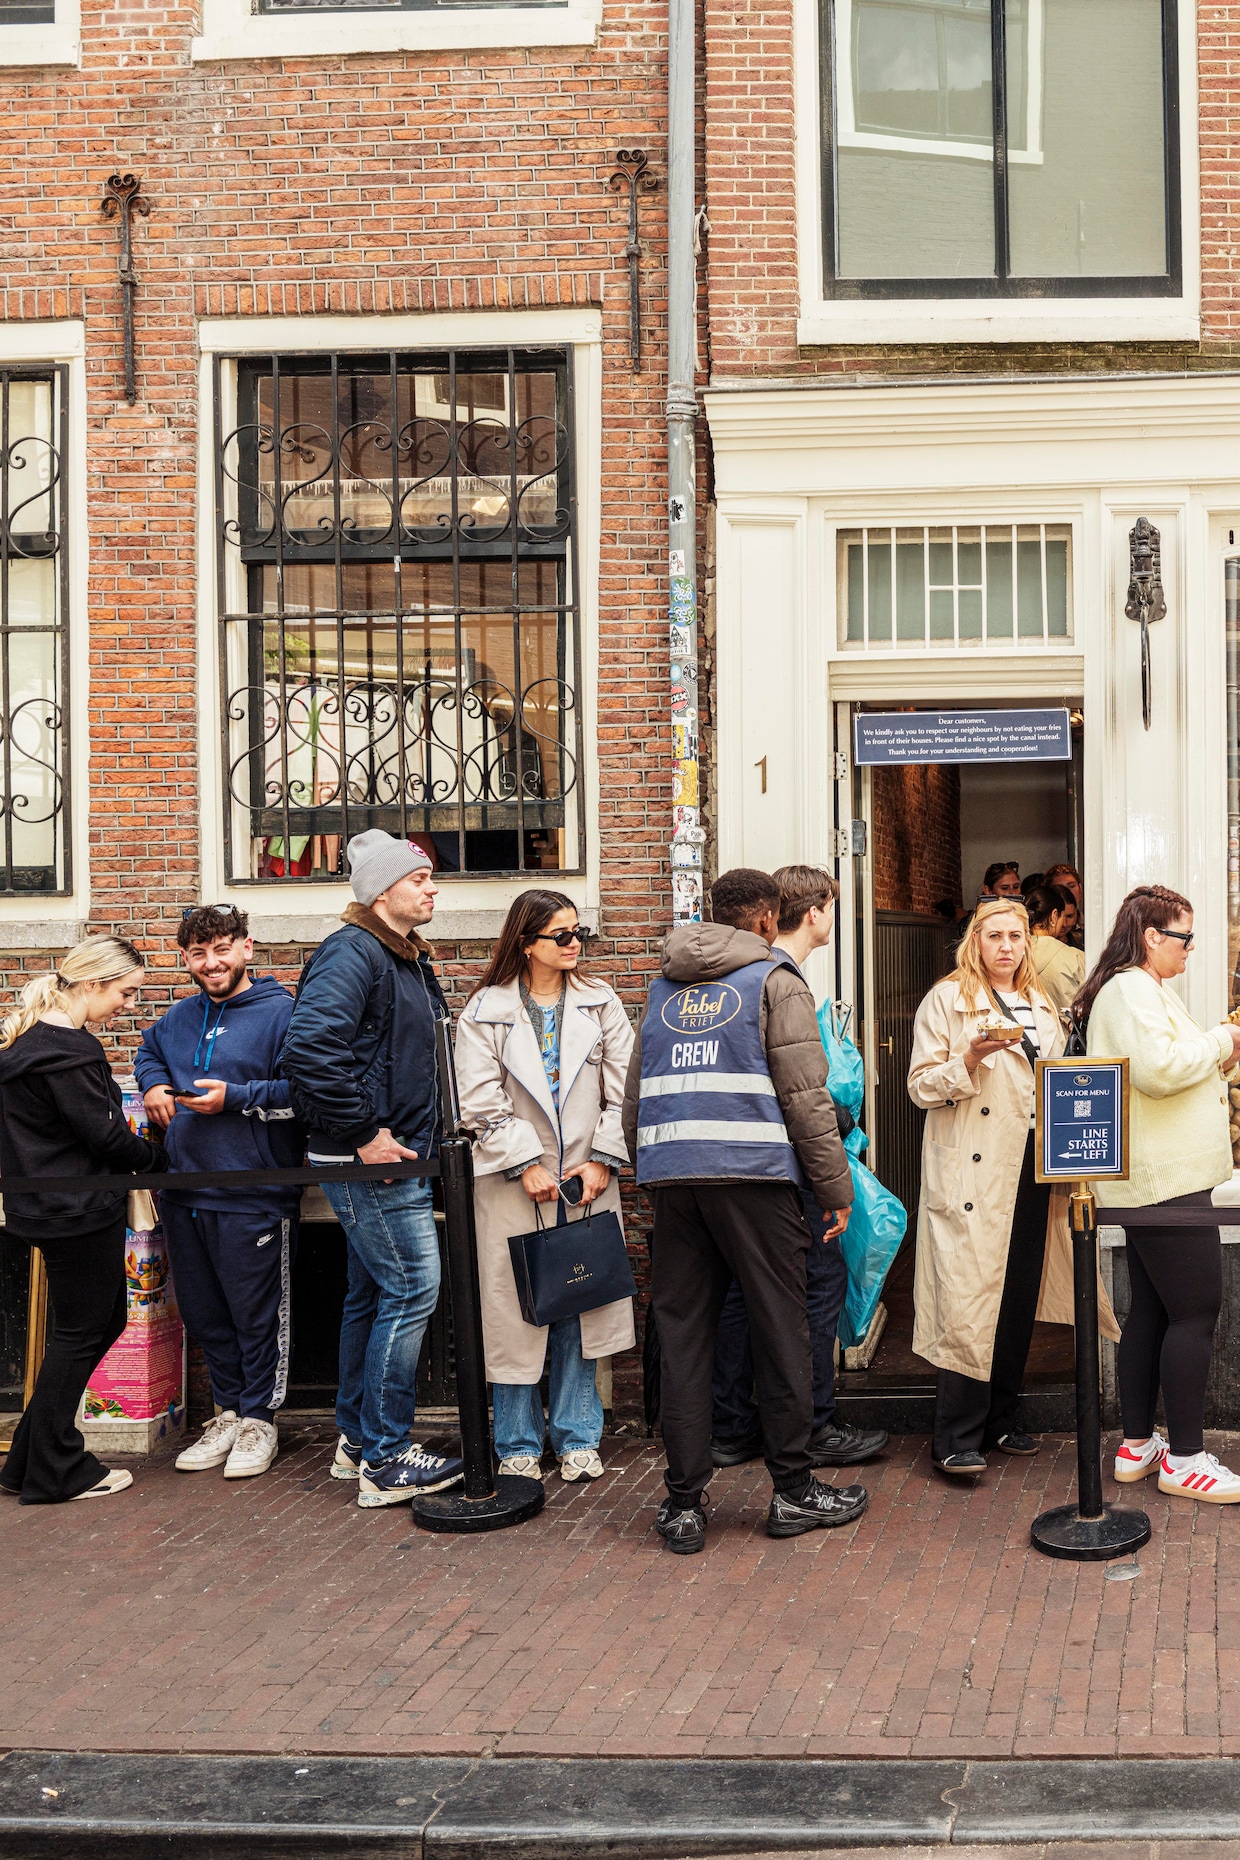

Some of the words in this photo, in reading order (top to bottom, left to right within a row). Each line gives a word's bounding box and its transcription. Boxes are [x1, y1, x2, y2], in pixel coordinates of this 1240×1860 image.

[874, 728, 893, 737] kindly
[925, 728, 947, 736] respect
[960, 726, 993, 735] neighbours
[994, 726, 1002, 734] by
[1014, 725, 1033, 733] eating
[986, 735, 1000, 743] spot
[888, 748, 906, 756] Thank
[945, 746, 988, 755] understanding
[1000, 745, 1039, 753] cooperation!
[753, 754, 767, 794] 1
[677, 988, 728, 1018] Fabel
[681, 1015, 716, 1028] FRIET
[670, 1040, 720, 1068] CREW
[1082, 1128, 1108, 1139] LINE
[1068, 1139, 1108, 1150] STARTS
[1083, 1149, 1108, 1160] LEFT
